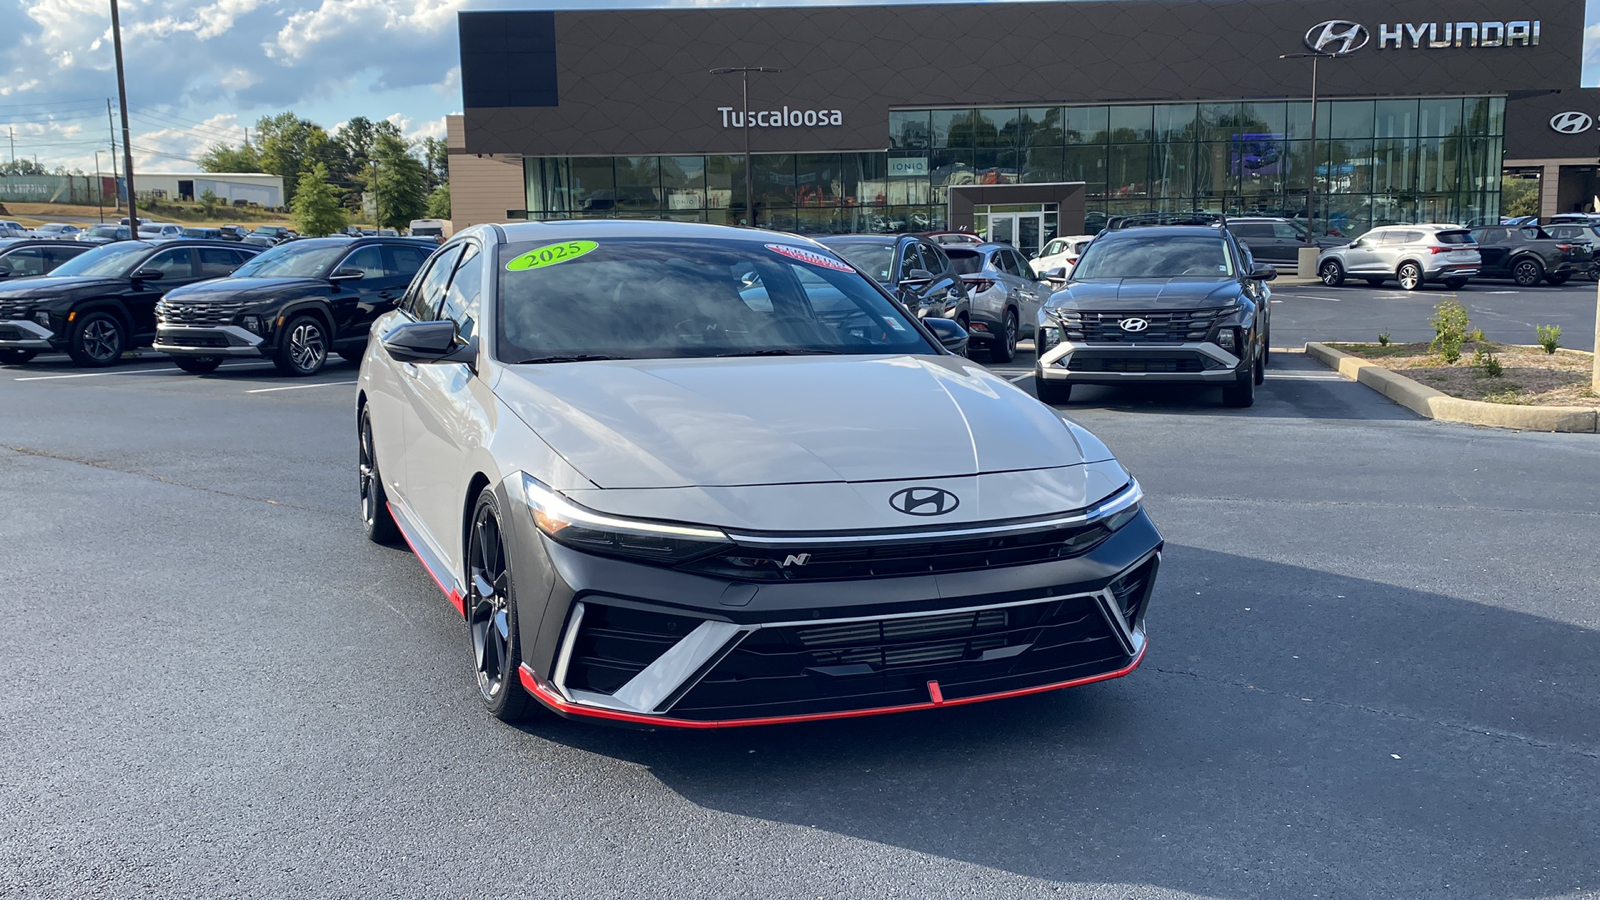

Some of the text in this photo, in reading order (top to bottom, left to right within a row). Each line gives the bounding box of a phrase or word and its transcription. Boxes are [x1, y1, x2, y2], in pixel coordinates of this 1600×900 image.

[1378, 20, 1541, 49] HYUNDAI
[717, 105, 843, 128] Tuscaloosa
[14, 183, 47, 193] SHIPPING
[524, 242, 581, 268] 2025
[782, 552, 812, 566] N
